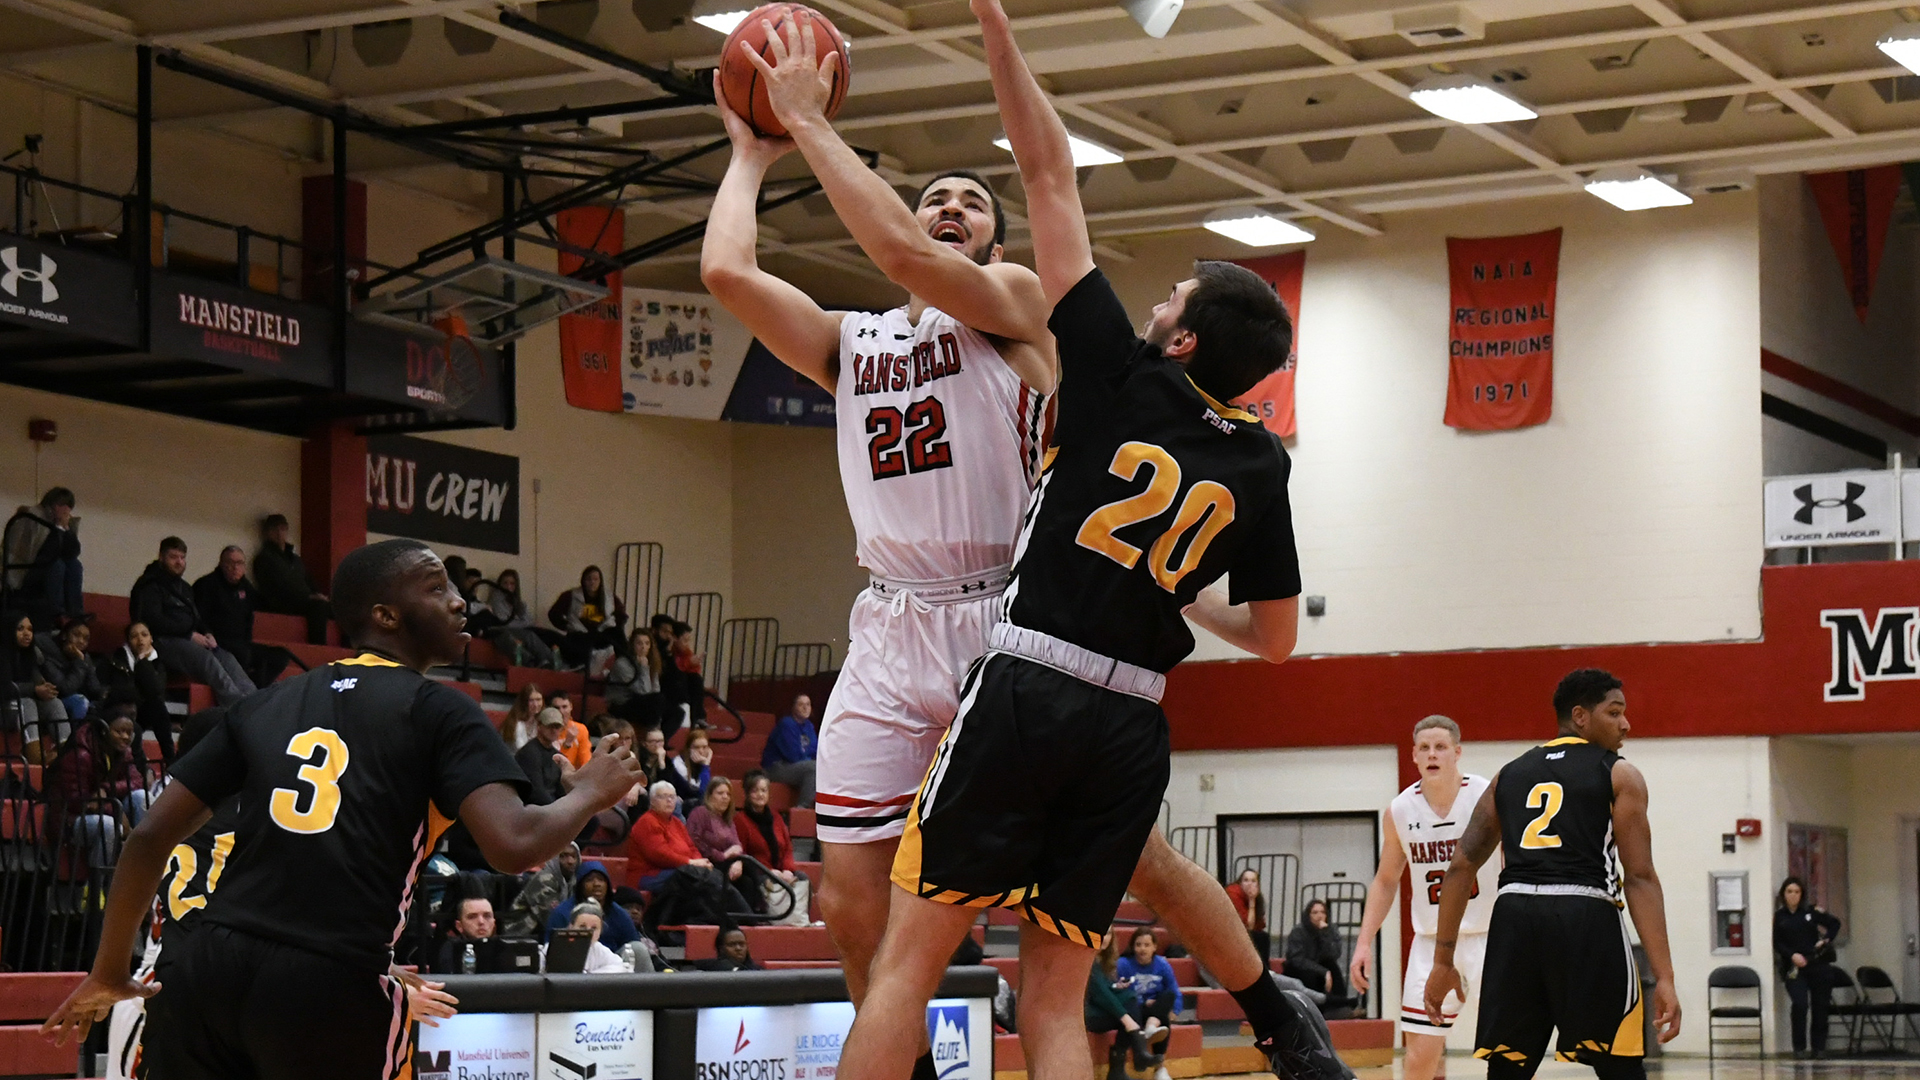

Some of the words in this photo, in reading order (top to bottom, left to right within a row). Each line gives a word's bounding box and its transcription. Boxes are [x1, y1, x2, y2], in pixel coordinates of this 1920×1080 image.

[1473, 261, 1533, 281] NAIA
[0, 302, 26, 315] NDER
[28, 308, 69, 324] ARMOUR
[179, 293, 300, 346] MANSFIELD
[1455, 302, 1549, 326] REGIONAL
[1450, 335, 1553, 358] CHAMPIONS
[852, 332, 962, 396] ANSIELD
[1475, 382, 1529, 402] 1971
[1202, 408, 1237, 435] PSAC
[865, 395, 953, 481] 22
[366, 453, 416, 514] MU
[425, 472, 510, 522] CREW
[1075, 441, 1235, 594] 20
[1781, 532, 1822, 541] UNDER
[1827, 529, 1881, 540] ARMOUR
[1820, 606, 1920, 703] M
[270, 727, 349, 834] 3
[1520, 781, 1563, 849] 2
[1409, 839, 1458, 863] MANSF
[1425, 870, 1479, 905] 2
[575, 1020, 636, 1044] Benedict's
[812, 1034, 840, 1048] RIDGE
[457, 1049, 492, 1061] Mansfield
[494, 1049, 531, 1060] University
[936, 1041, 961, 1061] ELITE
[457, 1065, 530, 1080] Bookstore
